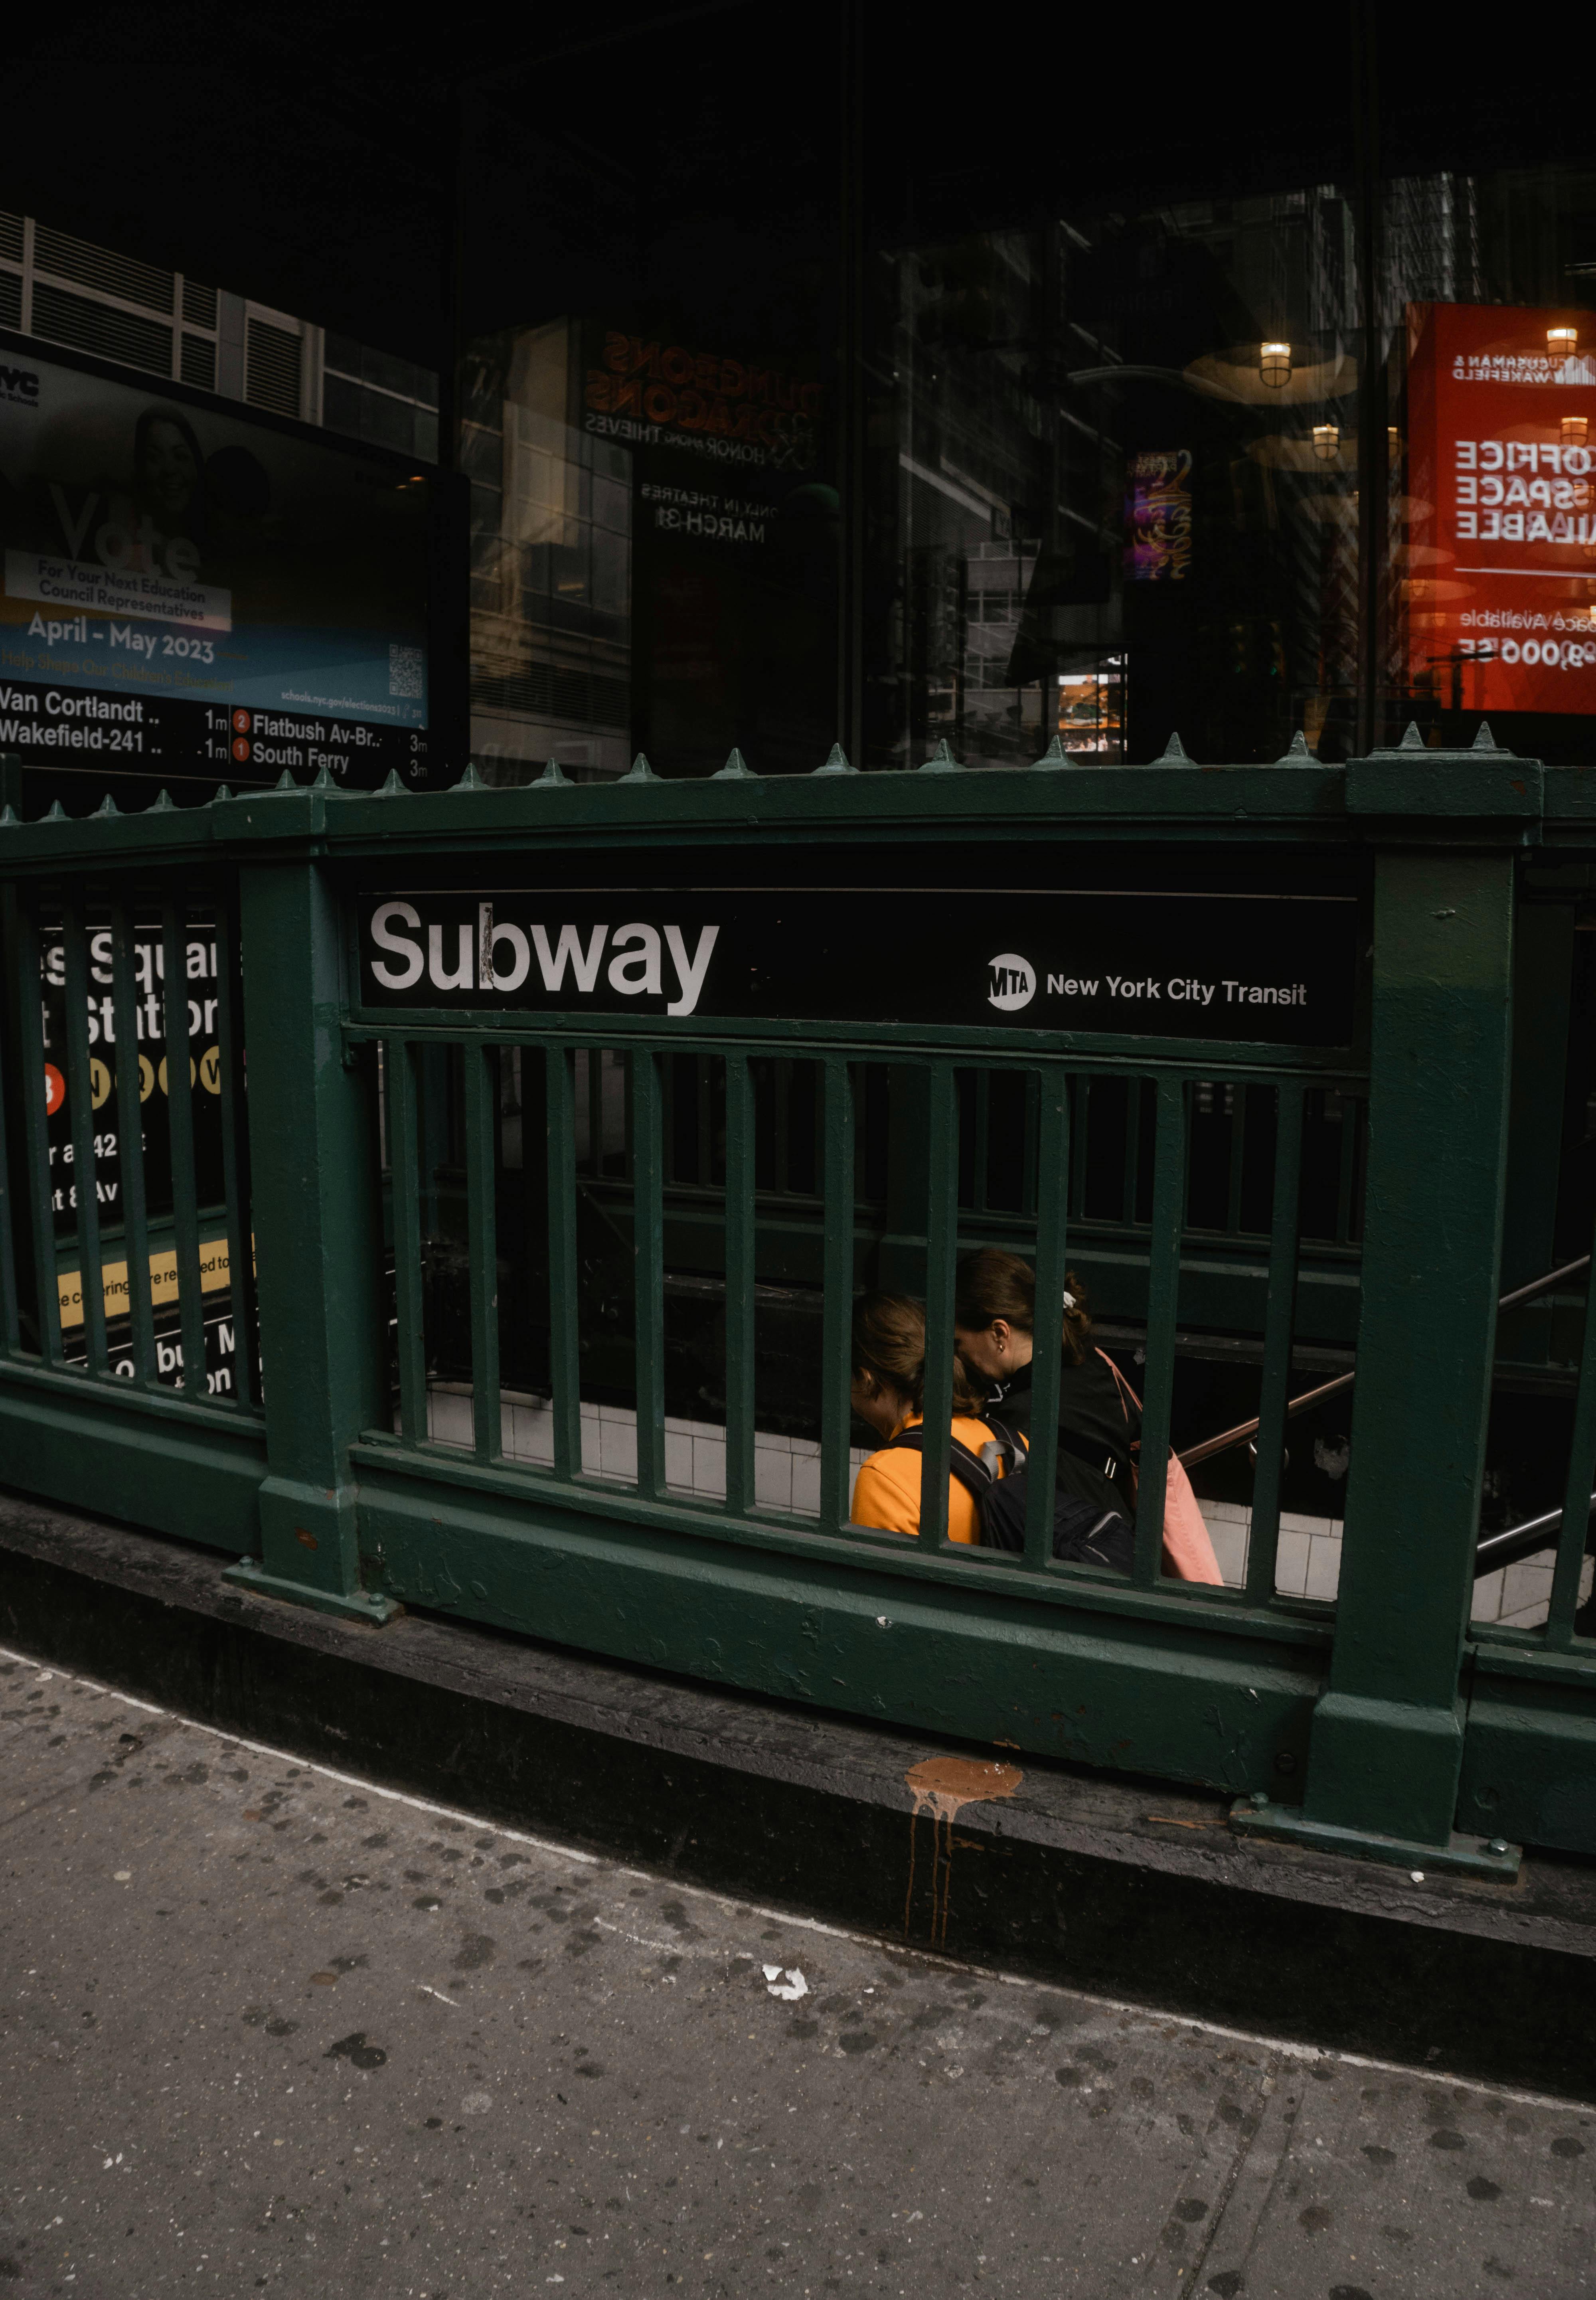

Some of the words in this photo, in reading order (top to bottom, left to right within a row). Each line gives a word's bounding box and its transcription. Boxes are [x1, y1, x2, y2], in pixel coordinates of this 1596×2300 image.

[48, 482, 203, 582] Vote
[38, 560, 62, 577] For
[67, 563, 101, 585] Your
[105, 573, 137, 591] Next
[142, 579, 205, 604] Education
[40, 580, 94, 602] Council
[98, 589, 204, 621] Representatives
[28, 611, 87, 646] April
[110, 621, 158, 659] May
[162, 635, 214, 664] 2023
[2, 649, 35, 671] Help
[38, 652, 79, 674] Shape
[83, 659, 108, 677] Our
[111, 661, 172, 684] Children's
[0, 686, 38, 713] Van
[45, 691, 144, 723] Cortlandt
[205, 709, 228, 731] 1m
[237, 715, 246, 729] 2
[253, 713, 325, 741] Flatbush
[409, 734, 428, 753] 3m
[281, 690, 396, 716] schools.nyc.gov/elections2023
[0, 719, 143, 753] Wakefield-241
[205, 738, 228, 760] 1m
[238, 743, 245, 755] 1
[253, 742, 302, 767] South
[308, 747, 350, 774] Ferry
[409, 759, 428, 778] 3m
[370, 901, 720, 1016] Subway
[988, 965, 1031, 1000] MTA
[1047, 974, 1099, 996] New
[1105, 976, 1160, 999] York
[1167, 978, 1215, 1006] City
[1221, 980, 1307, 1006] Transit
[93, 1132, 118, 1158] 42
